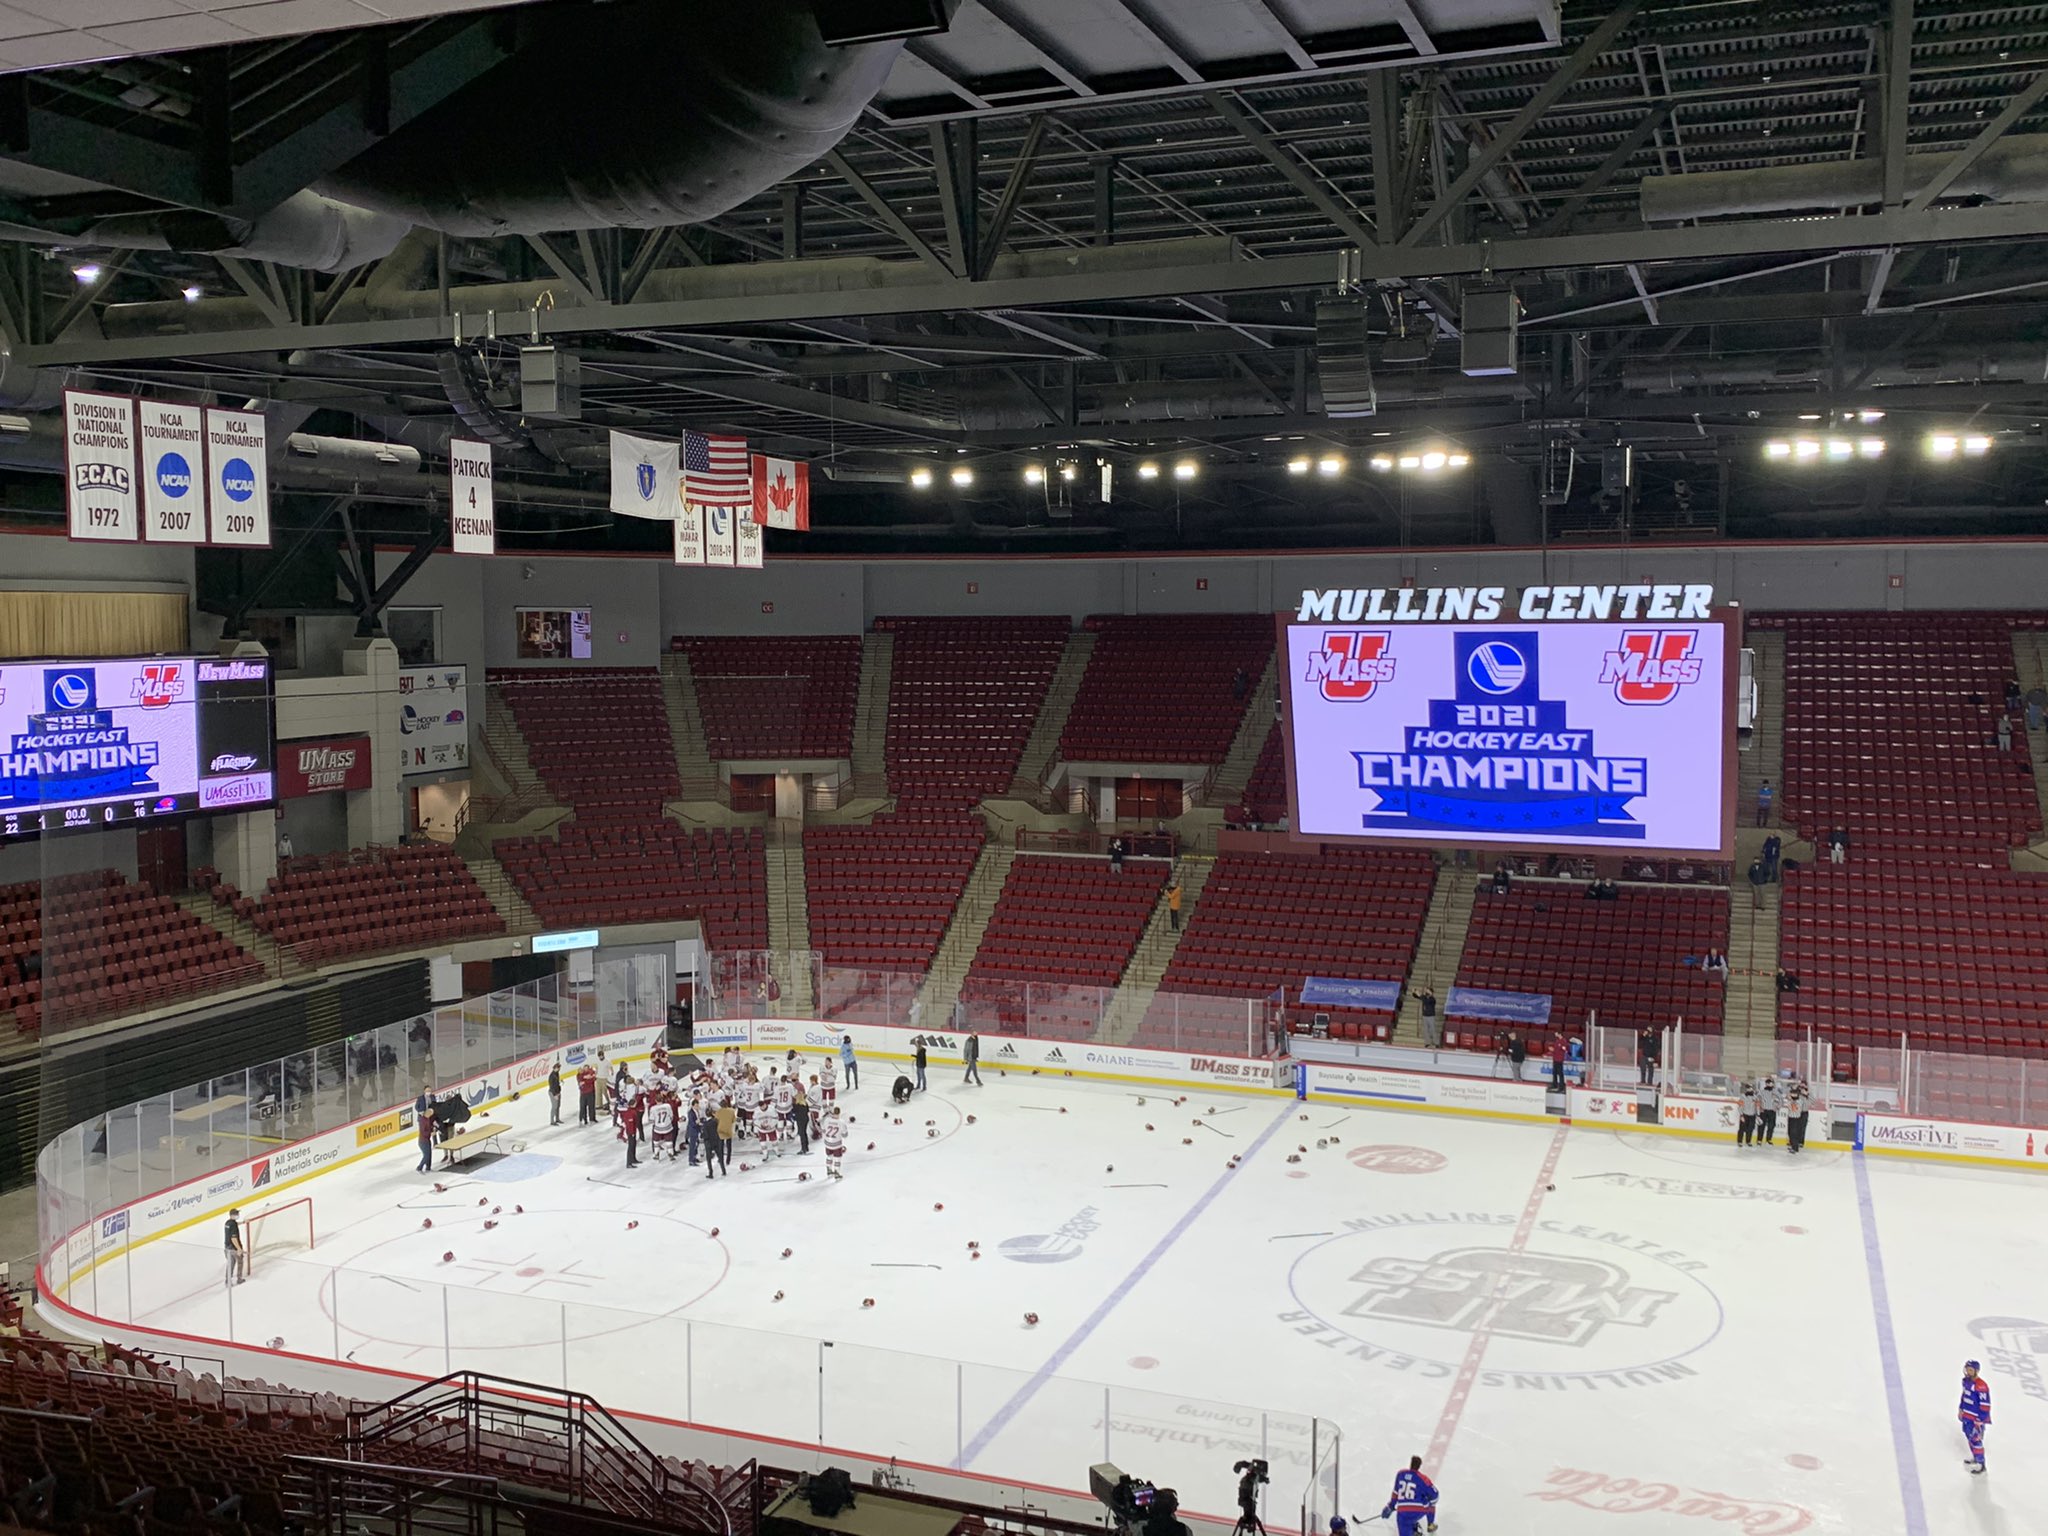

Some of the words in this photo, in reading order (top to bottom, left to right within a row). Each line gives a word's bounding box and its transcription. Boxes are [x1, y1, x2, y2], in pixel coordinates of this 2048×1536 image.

[74, 403, 116, 419] DIVISION
[119, 409, 126, 420] II
[160, 413, 183, 427] NCAA
[78, 419, 123, 435] NATIONAL
[143, 425, 199, 442] TOURNAMENT
[226, 420, 248, 434] NCAA
[73, 433, 129, 449] CHAMPIONS
[210, 433, 264, 448] TOURNAMENT
[453, 458, 490, 478] PATRICK
[76, 464, 129, 491] ECAC
[160, 473, 190, 487] NCAA
[226, 479, 254, 492] NCAA
[468, 487, 477, 509] 4
[88, 507, 119, 527] 1972
[160, 512, 191, 530] 2007
[226, 515, 254, 533] 2019
[454, 519, 492, 536] KEENAN
[683, 547, 697, 558] 2019
[709, 544, 732, 556] 2018-19
[743, 546, 757, 557] 2019
[1298, 587, 1505, 621] MULLINS
[1519, 584, 1713, 620] CENTER
[1456, 705, 1537, 726] 2021
[17, 732, 85, 749] HOCKEY
[86, 730, 125, 743] EAST
[1413, 731, 1520, 750] HOCKEY
[1519, 733, 1587, 751] EAST
[0, 743, 157, 777] HAMPIONS
[308, 770, 346, 786] STORE
[1362, 754, 1644, 794] CHAMPIONS
[66, 808, 87, 820] 00.0
[104, 807, 114, 821] 0
[134, 807, 145, 817] 16
[5, 823, 19, 834] 22
[38, 815, 46, 830] 1
[694, 1025, 748, 1036] TLANTIC
[612, 1040, 628, 1050] Hockey
[805, 1032, 844, 1047] Sandr
[779, 1091, 789, 1103] 18
[400, 1112, 412, 1125] CAT
[658, 1111, 668, 1123] 17
[363, 1120, 393, 1140] Milton
[826, 1126, 839, 1138] 22
[274, 1153, 286, 1167] All
[287, 1146, 311, 1162] States
[274, 1159, 312, 1179] Materials
[313, 1149, 339, 1165] Group
[148, 1210, 165, 1219] State
[1054, 1205, 1100, 1237] HOCKEY
[1070, 1219, 1102, 1240] EAST
[1340, 1211, 1517, 1232] MULLINS
[1539, 1219, 1710, 1273] CENTER
[1277, 1310, 1452, 1380] CENTER
[1985, 1346, 2017, 1378] EAST
[1482, 1361, 1699, 1392] MULLINS
[2011, 1351, 2048, 1402] HOCKEY
[1176, 1404, 1253, 1427] Dining
[1398, 1480, 1416, 1500] 26
